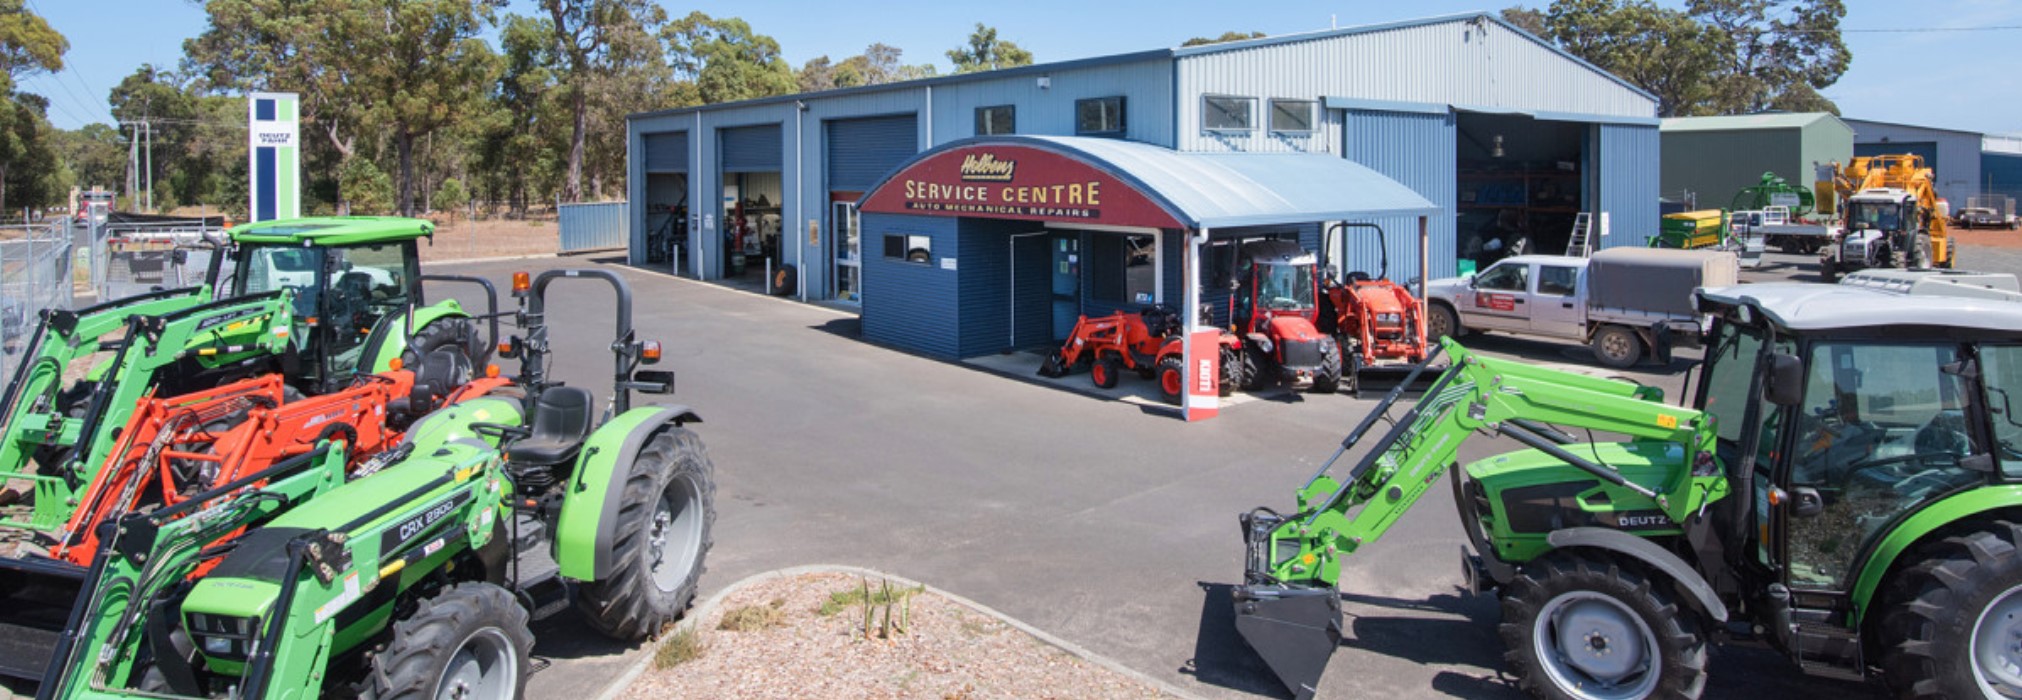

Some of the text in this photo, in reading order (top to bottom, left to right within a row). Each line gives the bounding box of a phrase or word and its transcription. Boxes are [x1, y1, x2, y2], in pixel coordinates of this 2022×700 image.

[905, 180, 1100, 205] SERVICE CENTRE
[912, 202, 1089, 217] AUTO MECHANICAL REPAIRS
[400, 516, 424, 541] CRX
